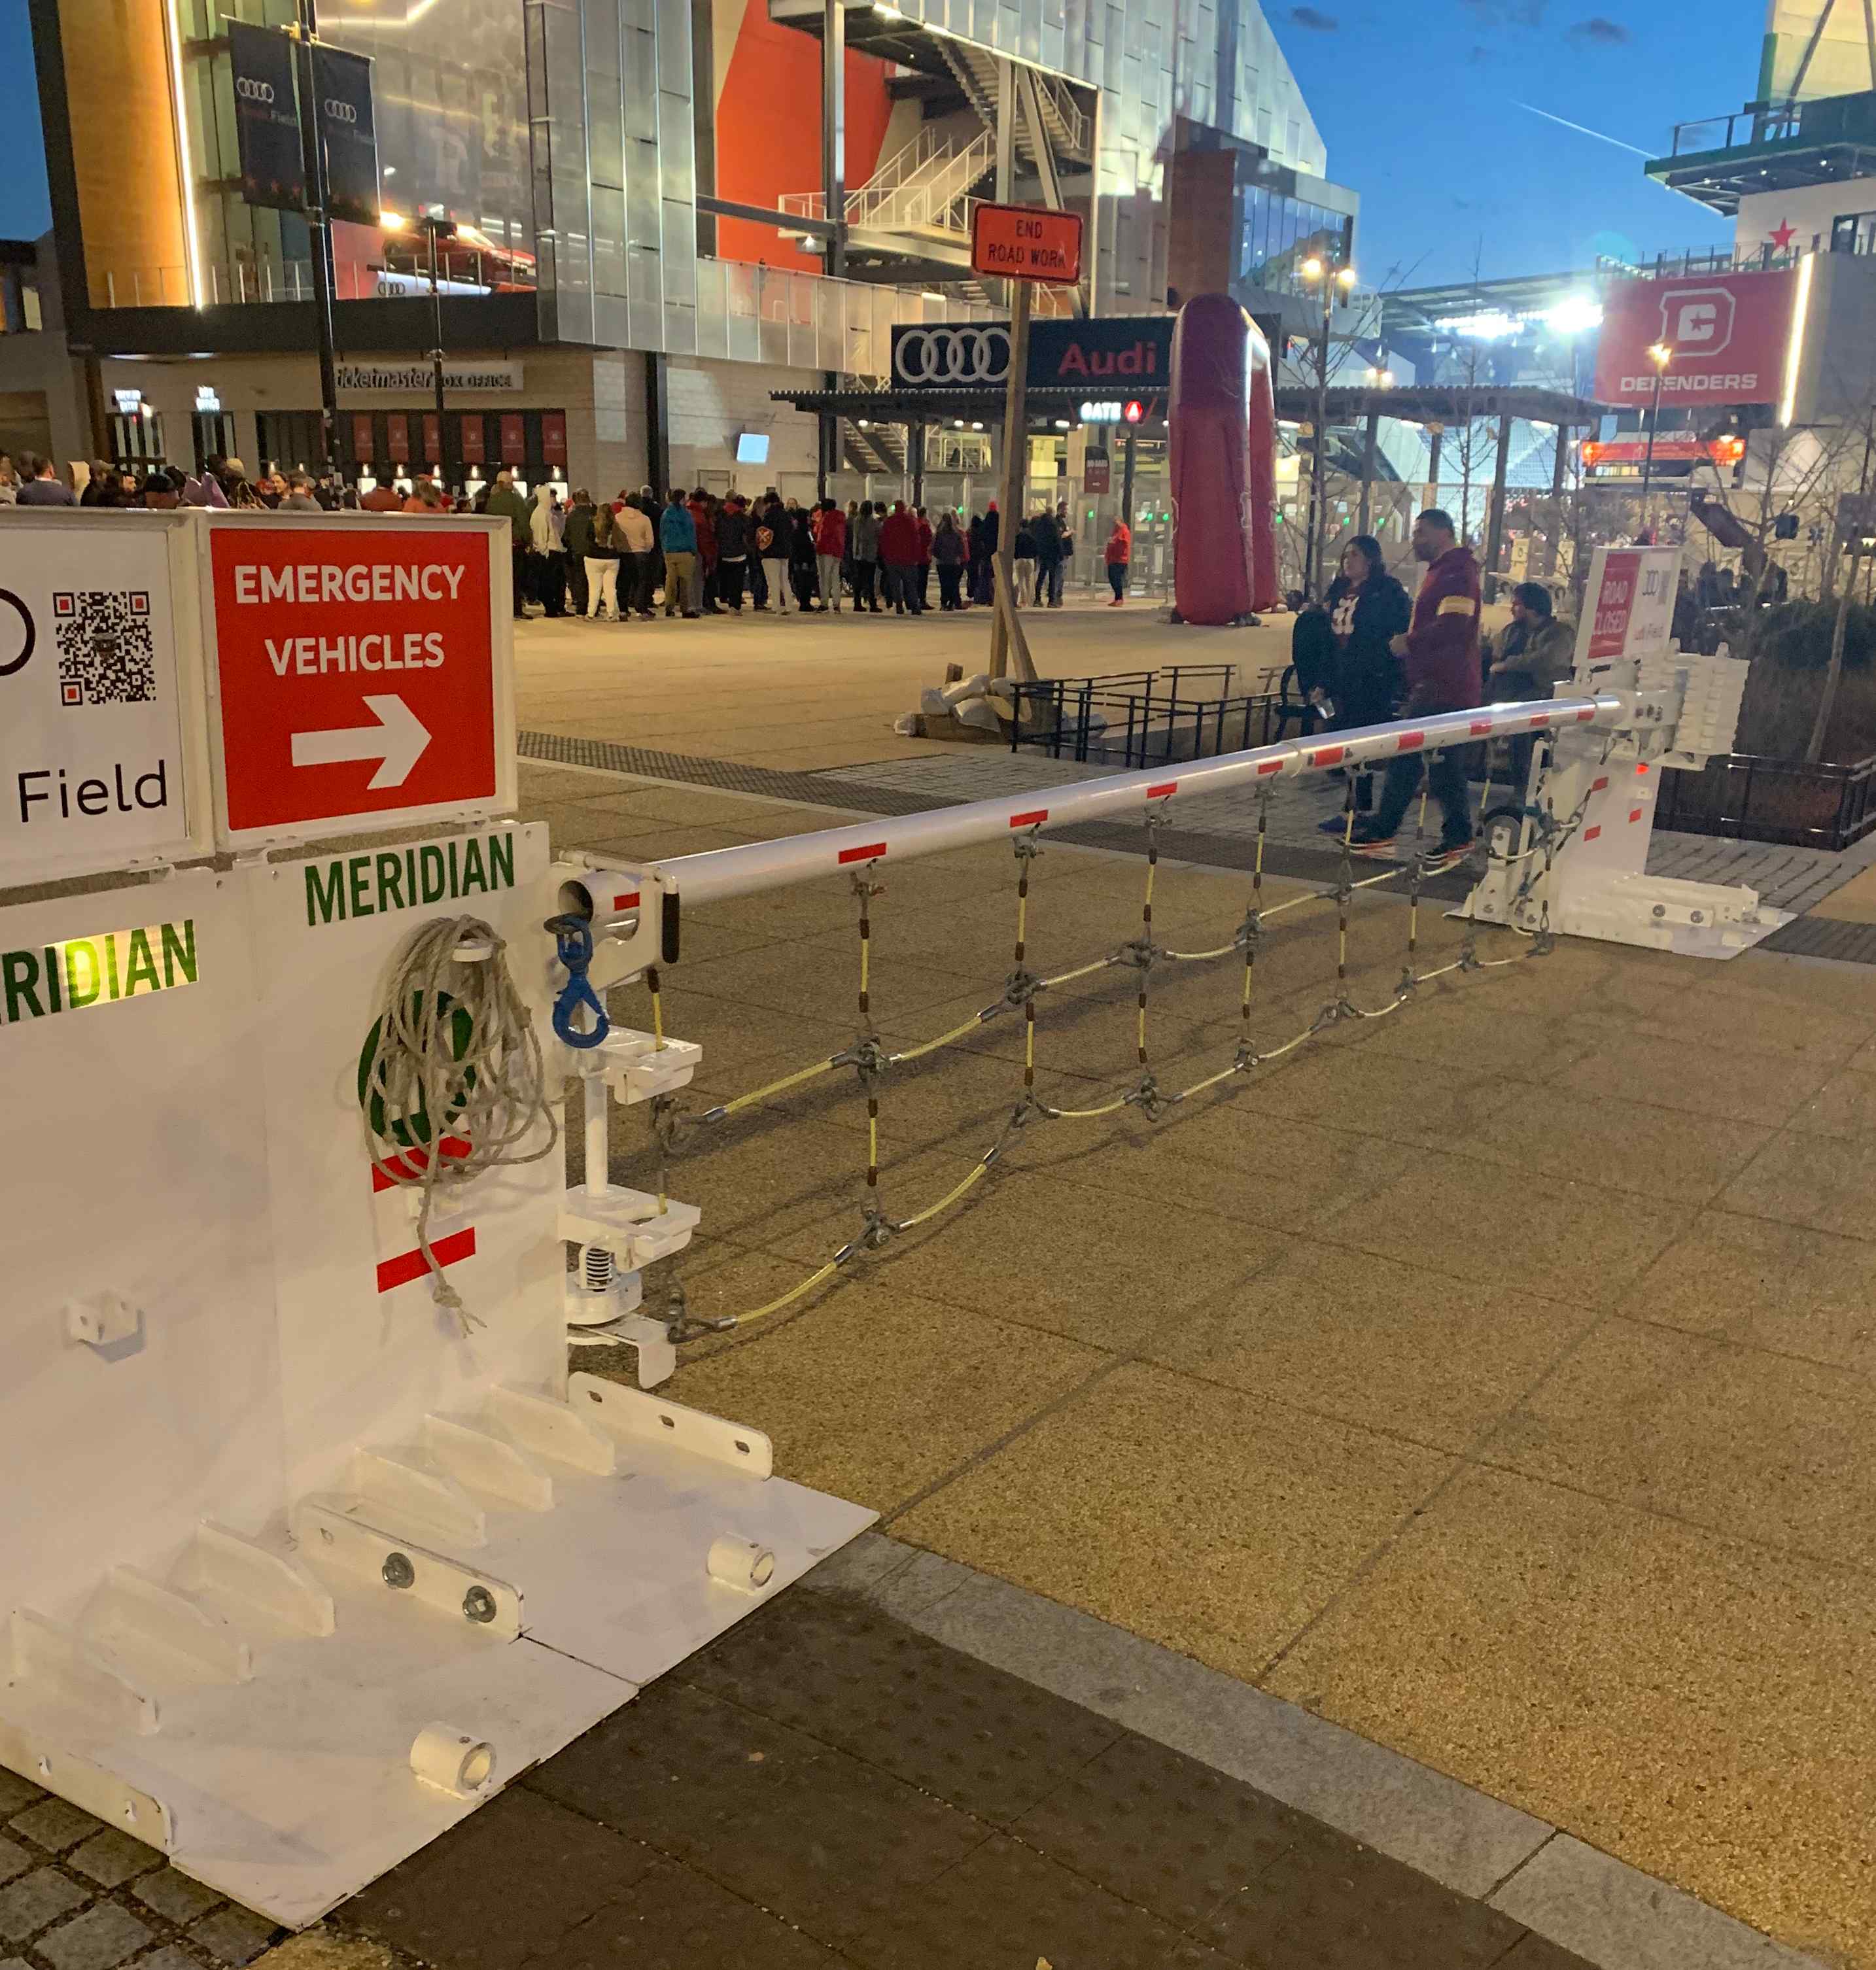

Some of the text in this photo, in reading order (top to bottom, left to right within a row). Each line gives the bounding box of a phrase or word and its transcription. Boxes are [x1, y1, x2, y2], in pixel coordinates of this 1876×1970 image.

[1016, 220, 1042, 239] END
[988, 243, 1066, 268] ROAD WORK
[1058, 342, 1156, 376] Audi
[338, 367, 433, 389] ticketmaster
[1620, 374, 1758, 392] DEFENDERS
[1081, 402, 1121, 421] GATE
[235, 564, 465, 604] EMERGENCY
[1602, 580, 1628, 605] ROAD
[1593, 610, 1628, 636] CLOSED
[266, 632, 444, 676] VEHICLES
[18, 759, 167, 822] Field
[305, 833, 515, 927] MERIDIAN
[0, 919, 198, 1024] RIDIAN
